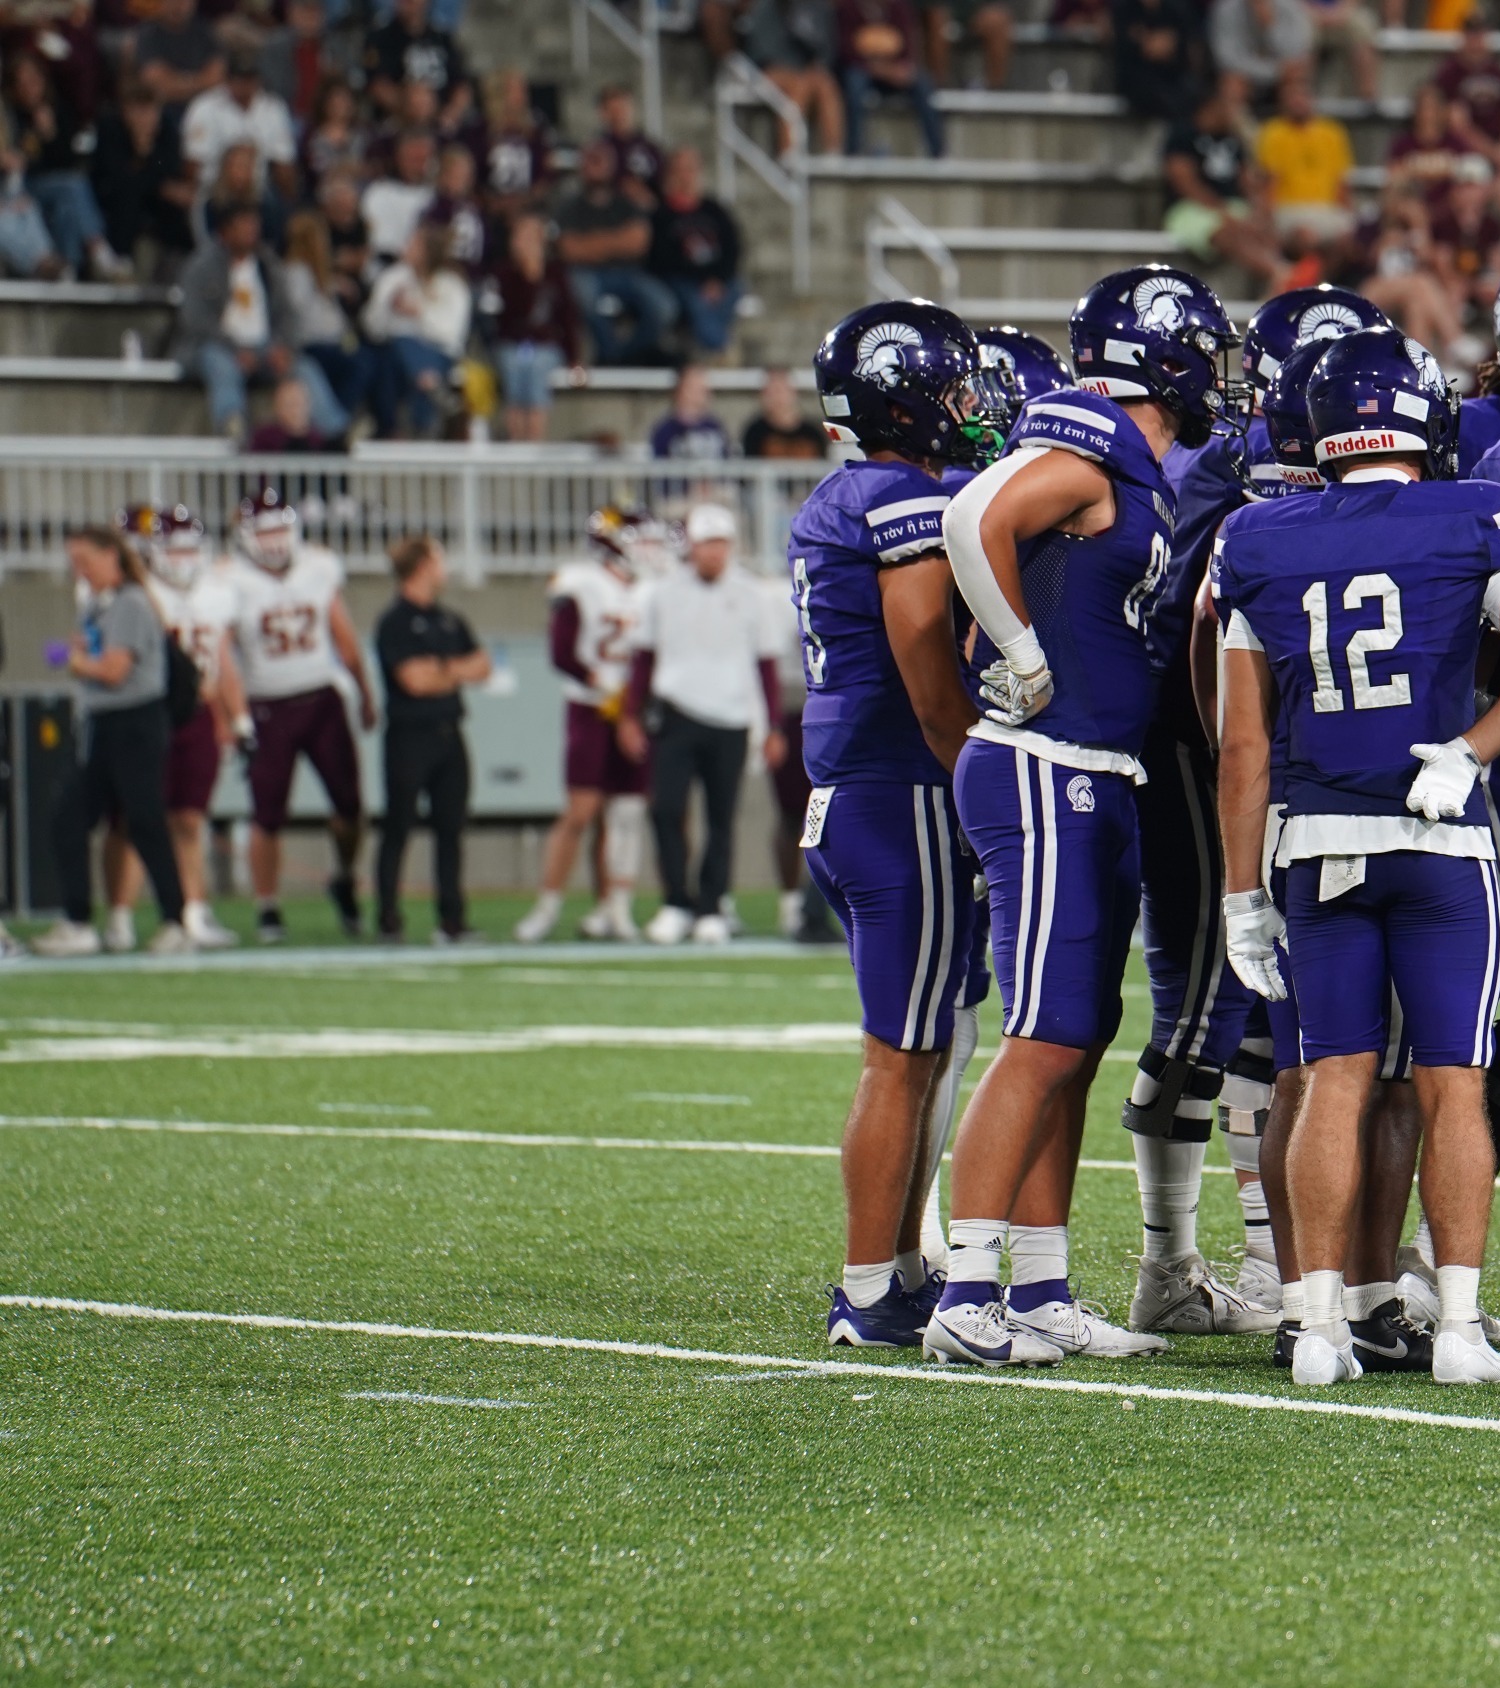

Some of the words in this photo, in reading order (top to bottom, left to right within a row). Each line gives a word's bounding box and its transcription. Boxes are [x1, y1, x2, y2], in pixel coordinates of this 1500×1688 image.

[1324, 433, 1395, 456] Riddell
[260, 606, 317, 660] 52
[1302, 573, 1412, 713] 12
